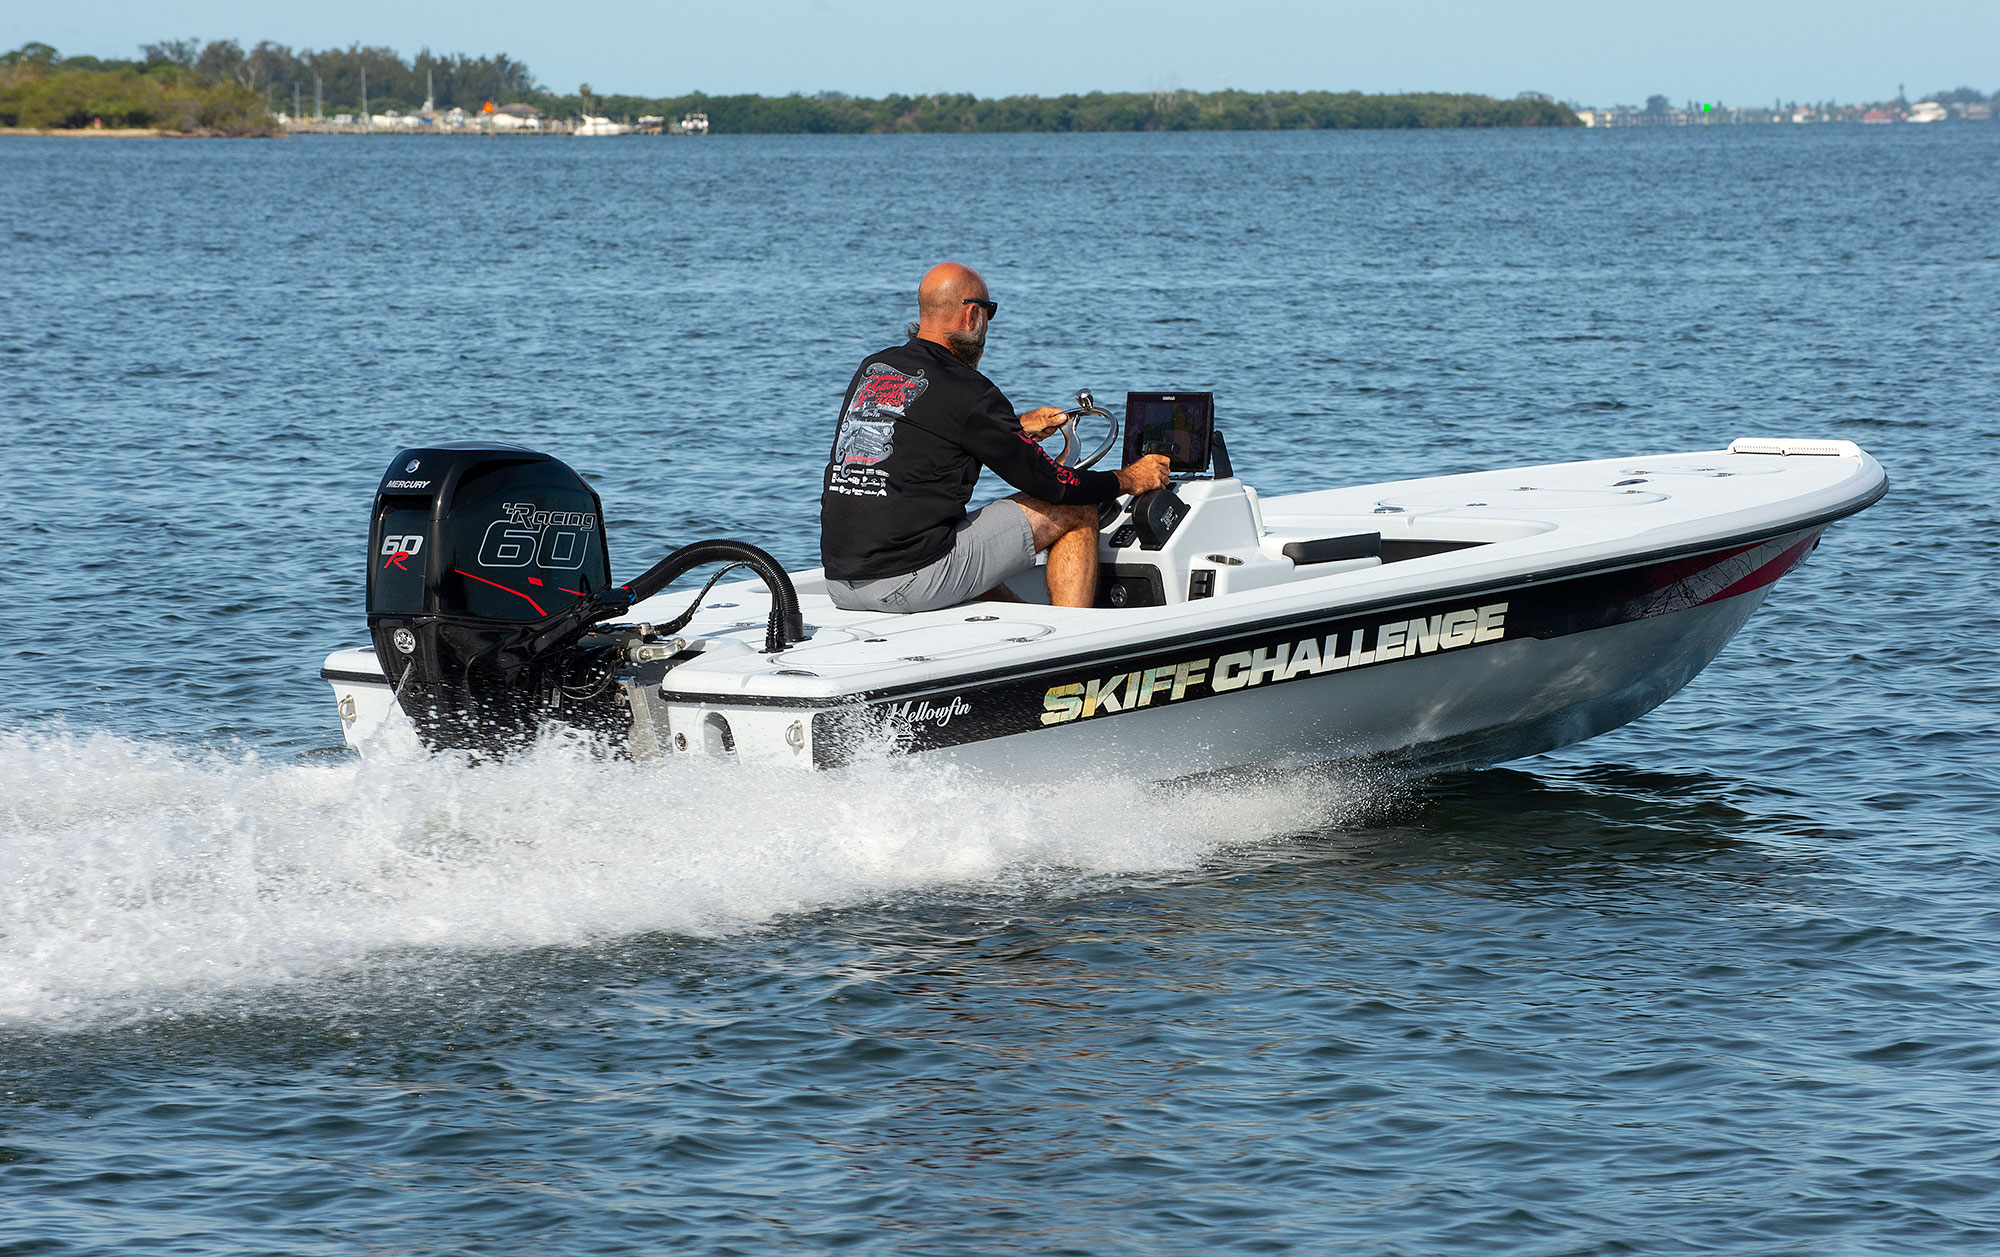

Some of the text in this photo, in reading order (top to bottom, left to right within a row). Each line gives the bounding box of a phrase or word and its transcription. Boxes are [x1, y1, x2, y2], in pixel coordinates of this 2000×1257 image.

[386, 480, 431, 489] MERCURY
[503, 502, 597, 531] Racing
[381, 535, 424, 555] 60
[478, 520, 590, 570] 60
[384, 552, 408, 571] R
[1040, 602, 1508, 725] SKIFF CHALLENGE
